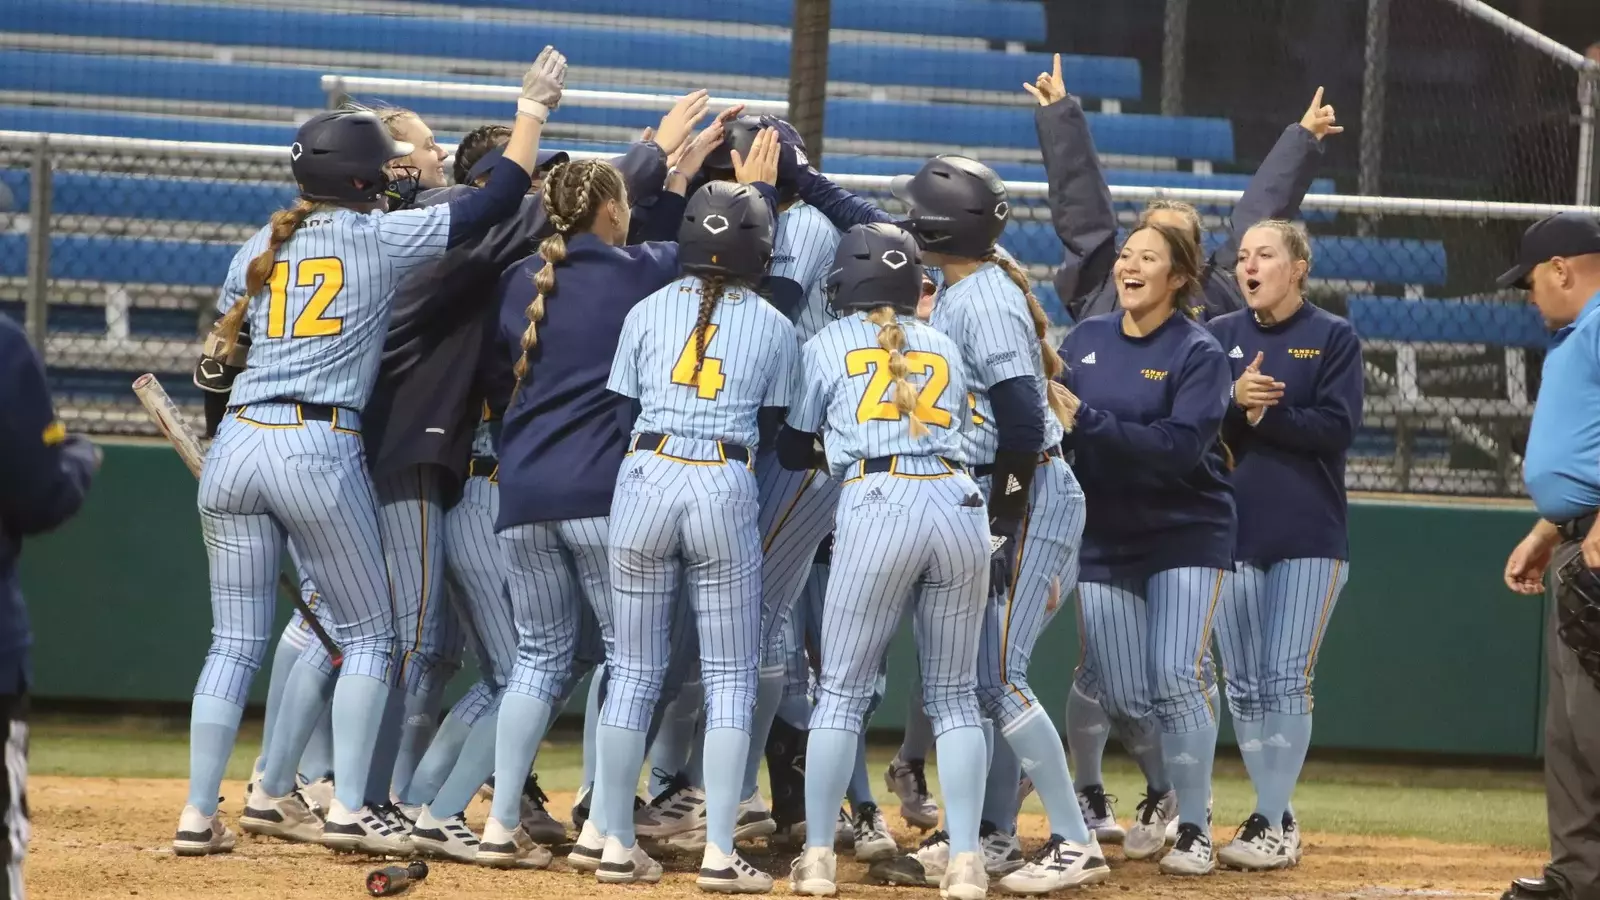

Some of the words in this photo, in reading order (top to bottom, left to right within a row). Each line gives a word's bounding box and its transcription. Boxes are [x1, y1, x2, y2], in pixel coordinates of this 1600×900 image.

[263, 255, 345, 340] 12
[670, 323, 727, 401] 4
[845, 347, 952, 430] 22
